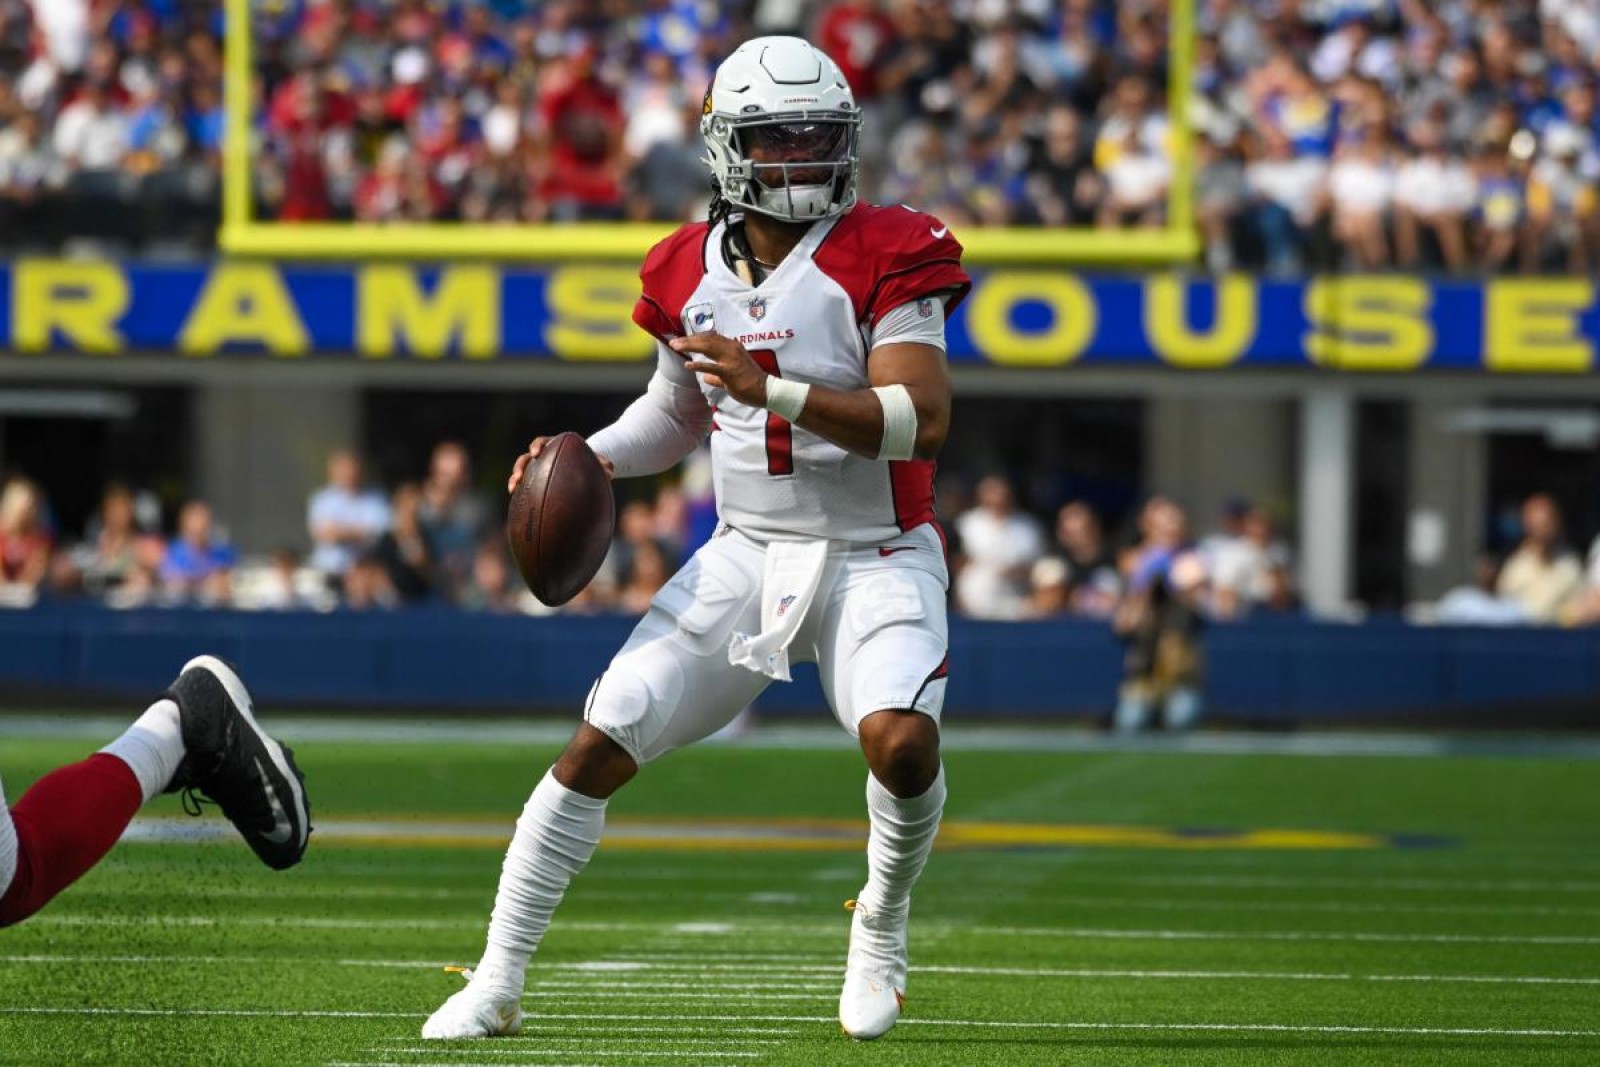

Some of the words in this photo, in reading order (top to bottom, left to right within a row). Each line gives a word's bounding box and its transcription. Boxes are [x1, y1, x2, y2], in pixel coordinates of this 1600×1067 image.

[10, 257, 653, 359] RAMS
[966, 270, 1595, 371] OUSE
[733, 328, 795, 343] ARDINALS
